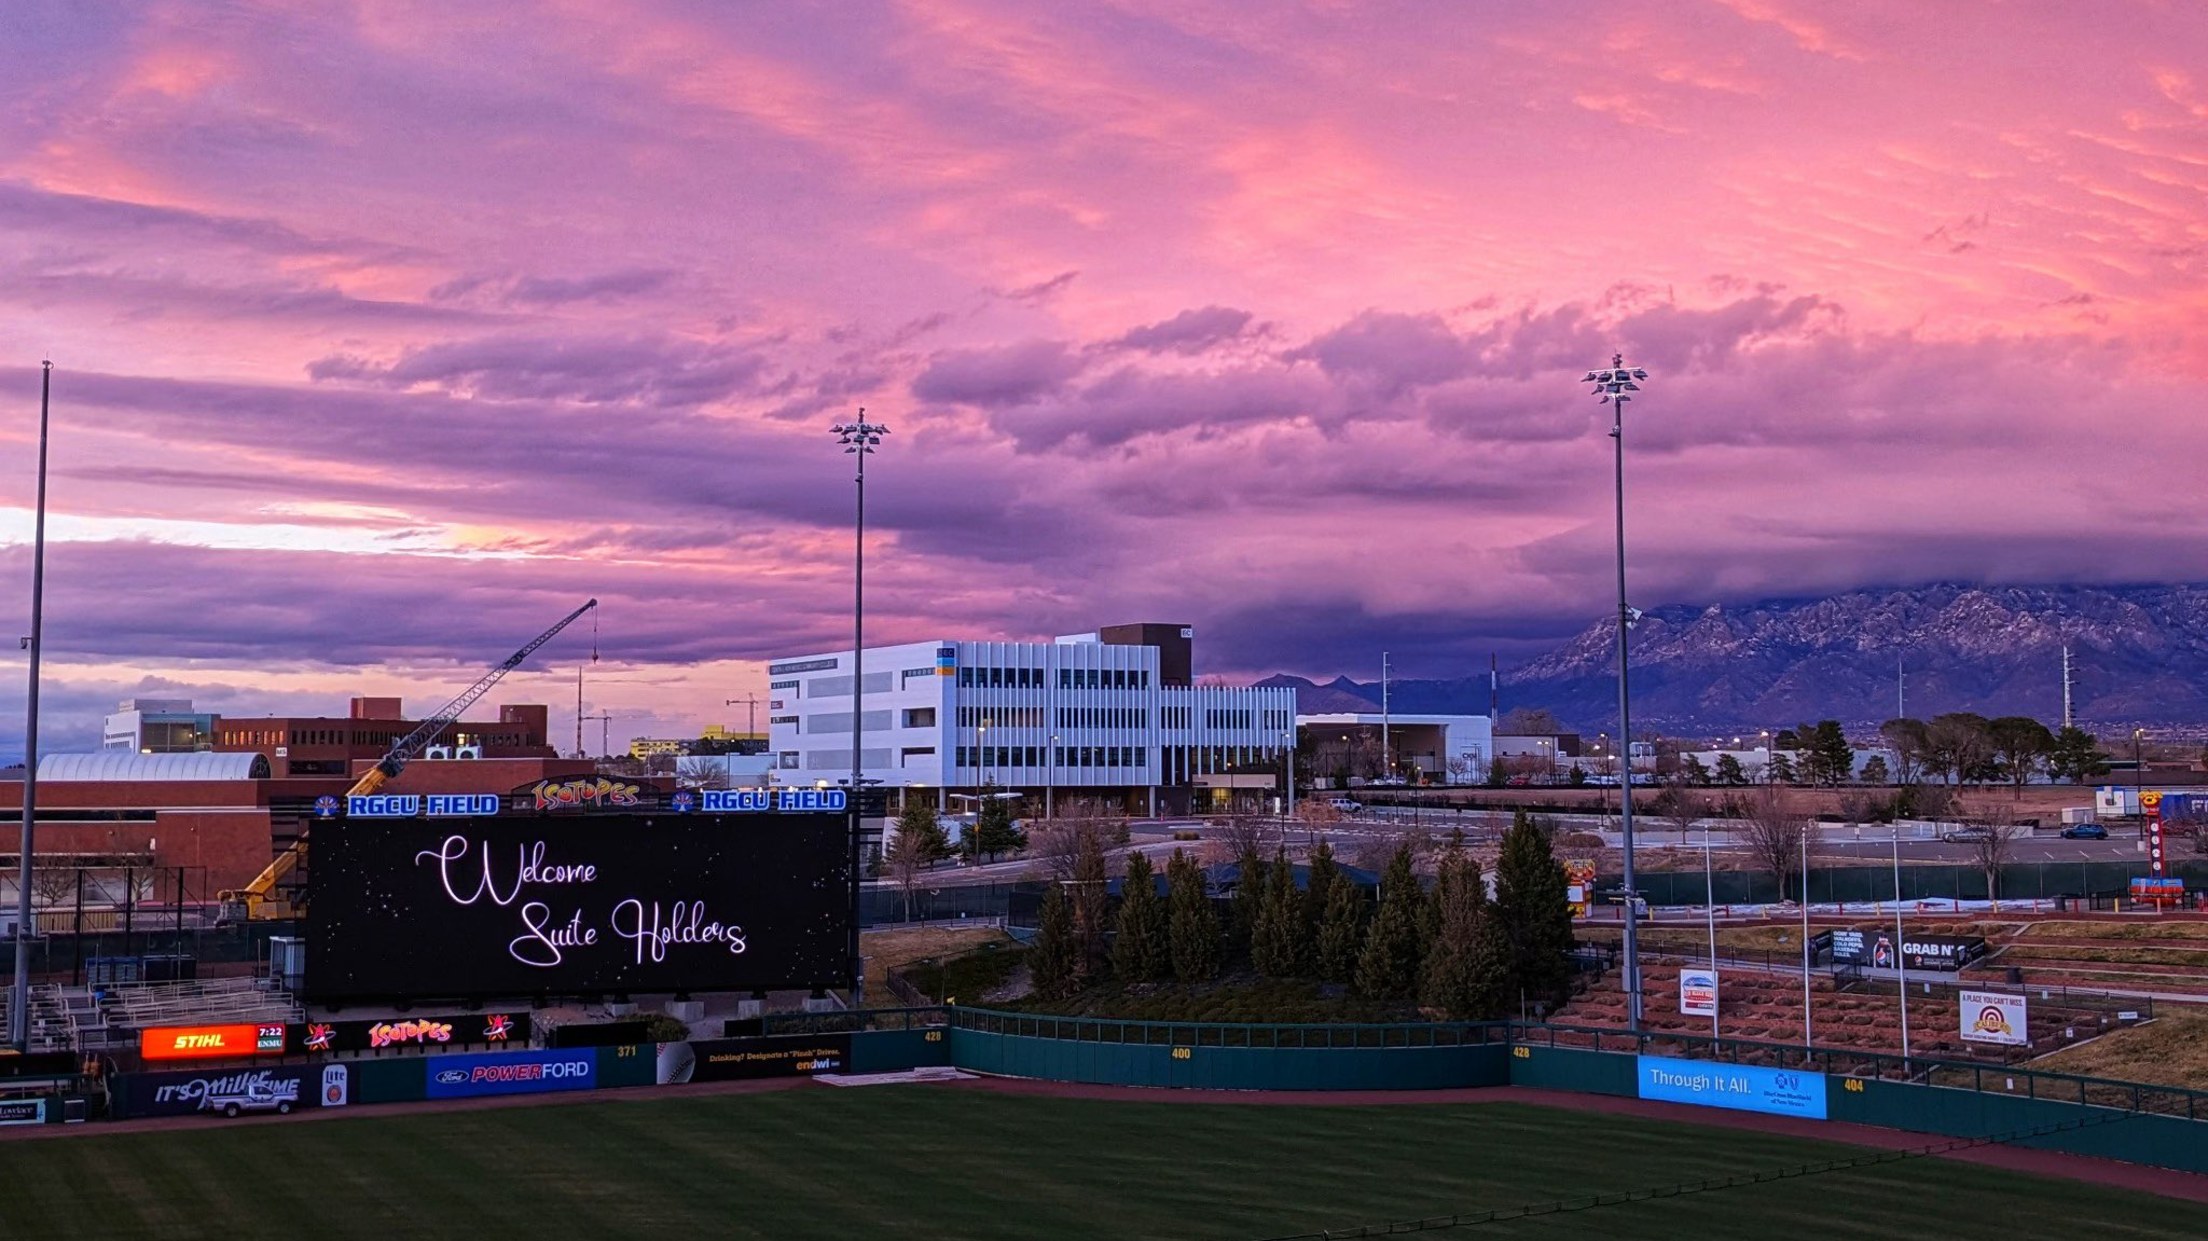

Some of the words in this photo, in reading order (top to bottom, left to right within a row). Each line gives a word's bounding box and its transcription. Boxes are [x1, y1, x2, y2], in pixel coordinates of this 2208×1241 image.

[348, 794, 419, 816] RGCU
[426, 794, 499, 816] FIELD
[702, 790, 769, 811] RGCU
[778, 790, 846, 811] FIELD
[415, 834, 597, 905] Welcome
[509, 902, 598, 966] Suite
[611, 899, 747, 965] Holders
[1902, 942, 1939, 955] GRAB
[1941, 944, 1954, 956] N'
[1966, 994, 1982, 1003] PLACE
[1983, 995, 1993, 1004] YOU
[1994, 997, 2009, 1005] CAN'T
[259, 1027, 282, 1037] 7:22
[924, 1031, 942, 1041] 428
[174, 1034, 225, 1049] STIHL
[257, 1039, 283, 1048] ENMU
[617, 1046, 637, 1057] 371
[709, 1053, 745, 1063] Drinking?
[747, 1051, 782, 1060] Designate
[1172, 1048, 1191, 1059] 400
[1513, 1047, 1530, 1058] 428
[796, 1058, 830, 1070] endwi
[326, 1070, 345, 1084] Lite
[439, 1070, 465, 1083] Ford
[1650, 1069, 1709, 1092] Through
[1715, 1076, 1724, 1091] It
[1729, 1078, 1751, 1094] All.
[1844, 1078, 1864, 1092] 404
[155, 1084, 190, 1102] IT'S
